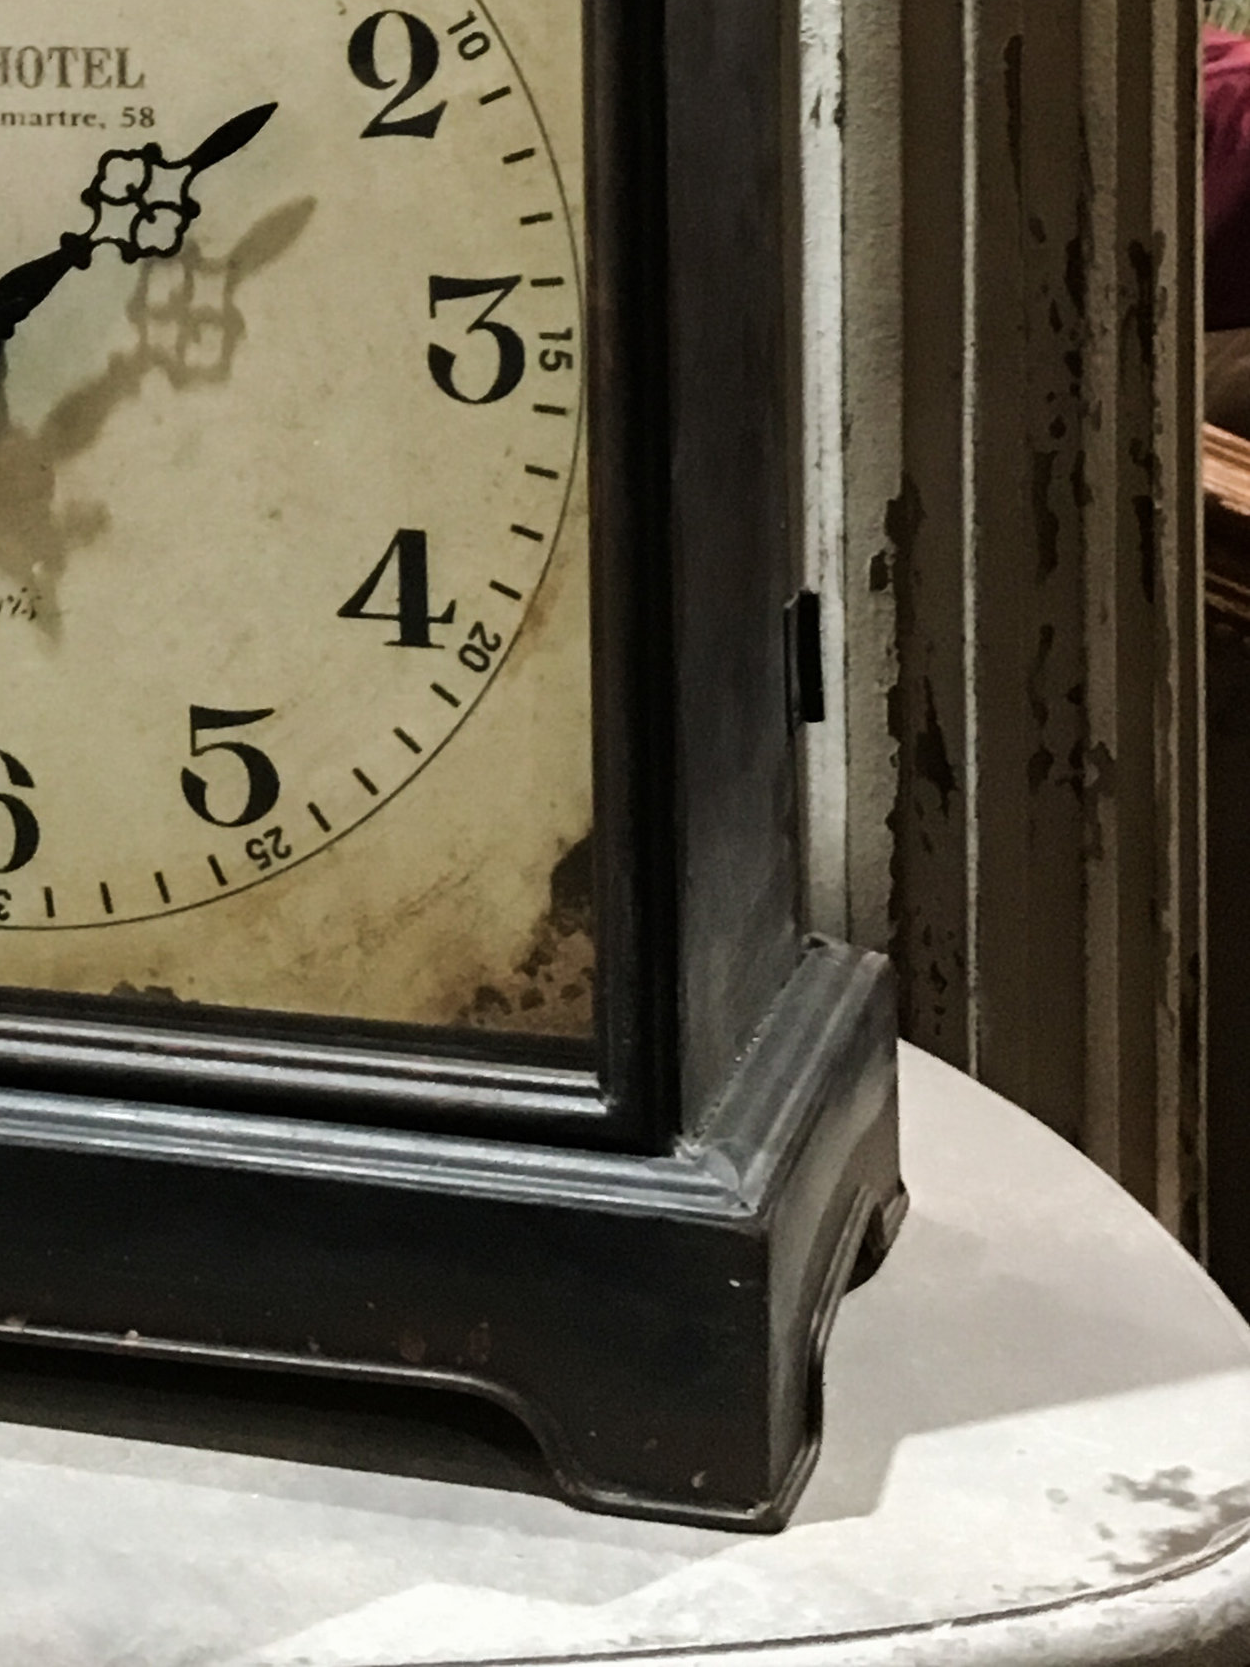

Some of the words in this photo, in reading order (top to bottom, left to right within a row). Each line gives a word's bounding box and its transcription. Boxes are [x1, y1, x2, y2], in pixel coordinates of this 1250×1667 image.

[446, 10, 491, 62] 10
[347, 10, 448, 139] 2
[120, 106, 156, 129] 58
[427, 275, 526, 405] 3
[538, 327, 573, 373] 15
[337, 528, 456, 649] 4
[457, 620, 502, 673] 20
[180, 704, 281, 828] 5
[244, 825, 293, 870] 25
